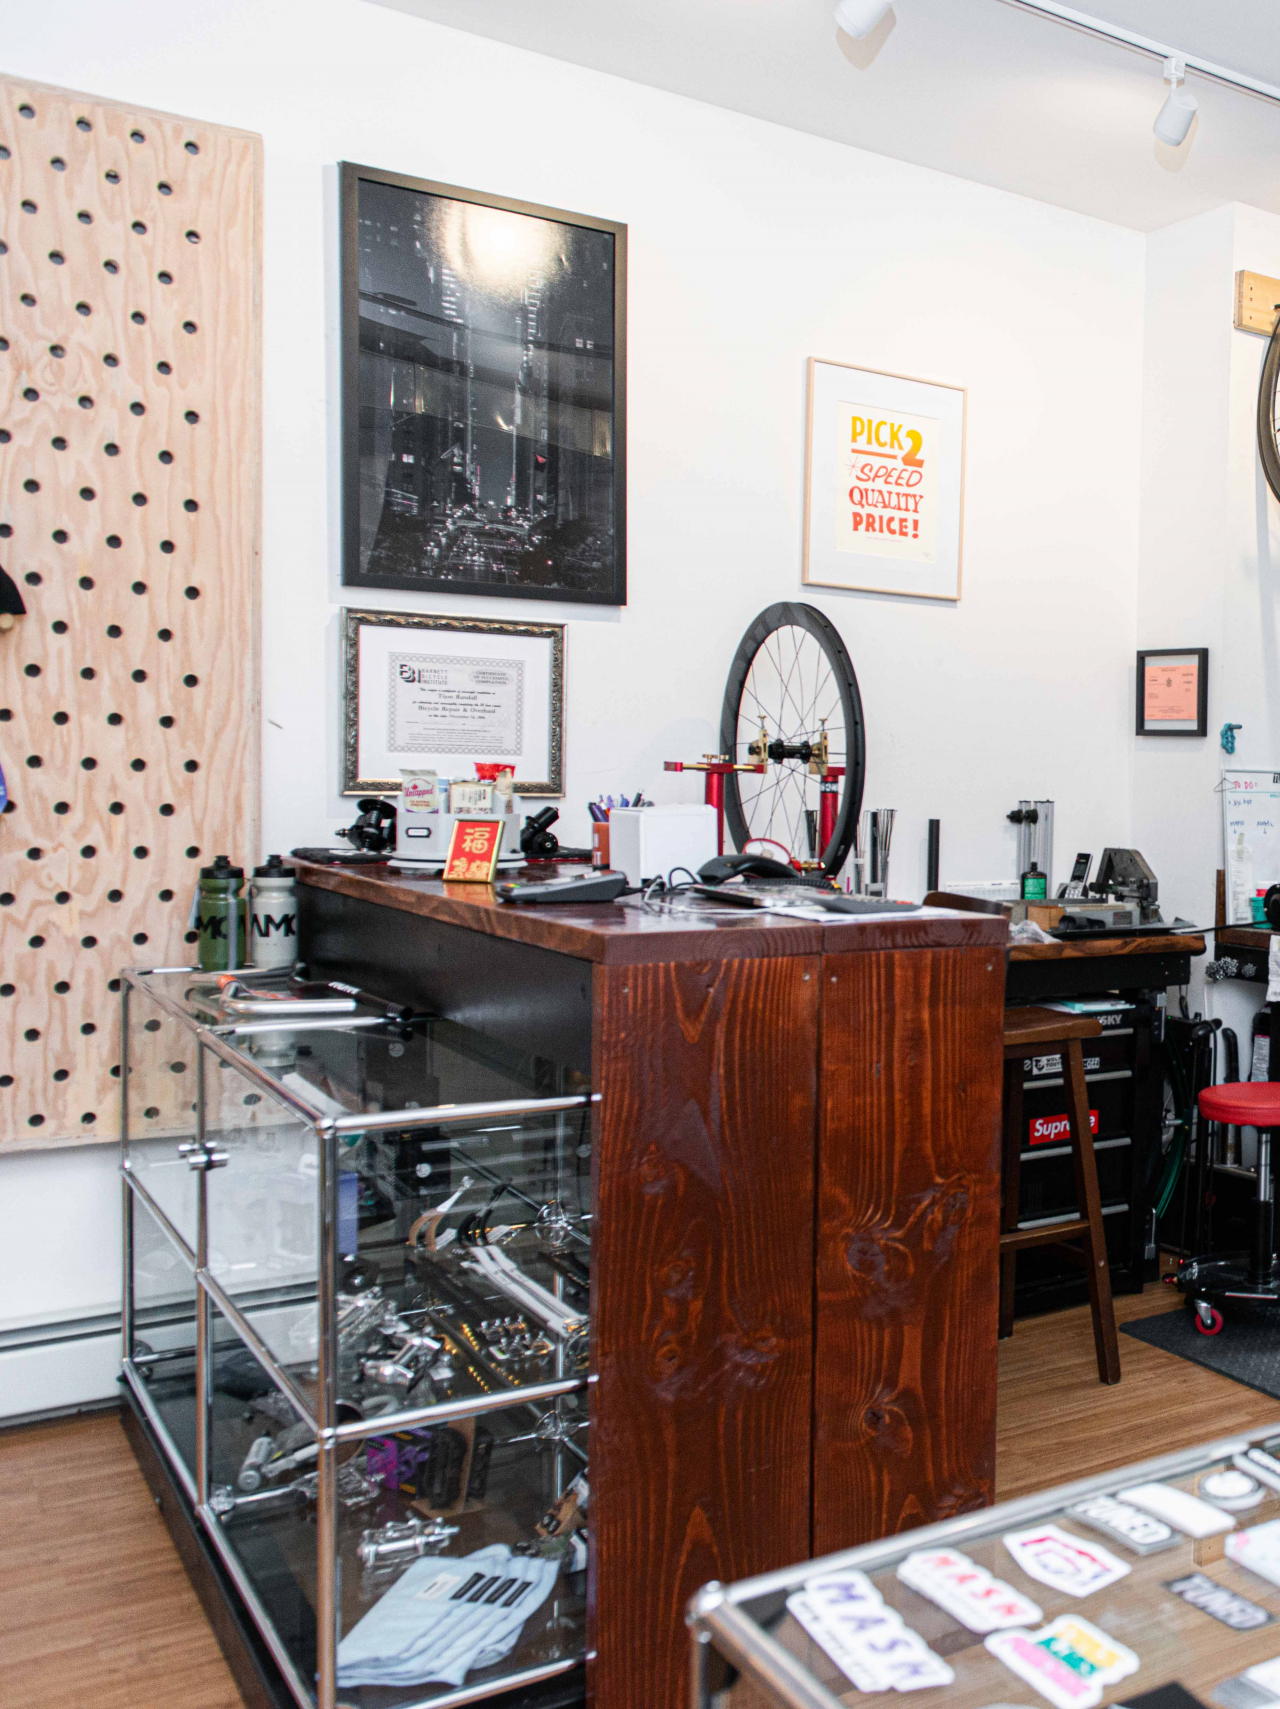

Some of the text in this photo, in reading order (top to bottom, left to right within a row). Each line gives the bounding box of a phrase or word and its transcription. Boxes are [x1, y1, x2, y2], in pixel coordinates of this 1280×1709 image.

[851, 416, 925, 468] PICK 2
[855, 462, 923, 488] SPEED
[849, 486, 924, 513] QUALITY
[852, 512, 919, 539] PRICE!
[418, 705, 439, 713] Bicycle
[441, 706, 461, 714] Repair
[404, 784, 434, 799] Untapped
[1233, 781, 1241, 790] TO
[462, 827, 491, 854] 福
[1033, 1116, 1096, 1139] Supre
[1169, 1573, 1270, 1629] TUNED
[817, 1582, 927, 1680] MASH
